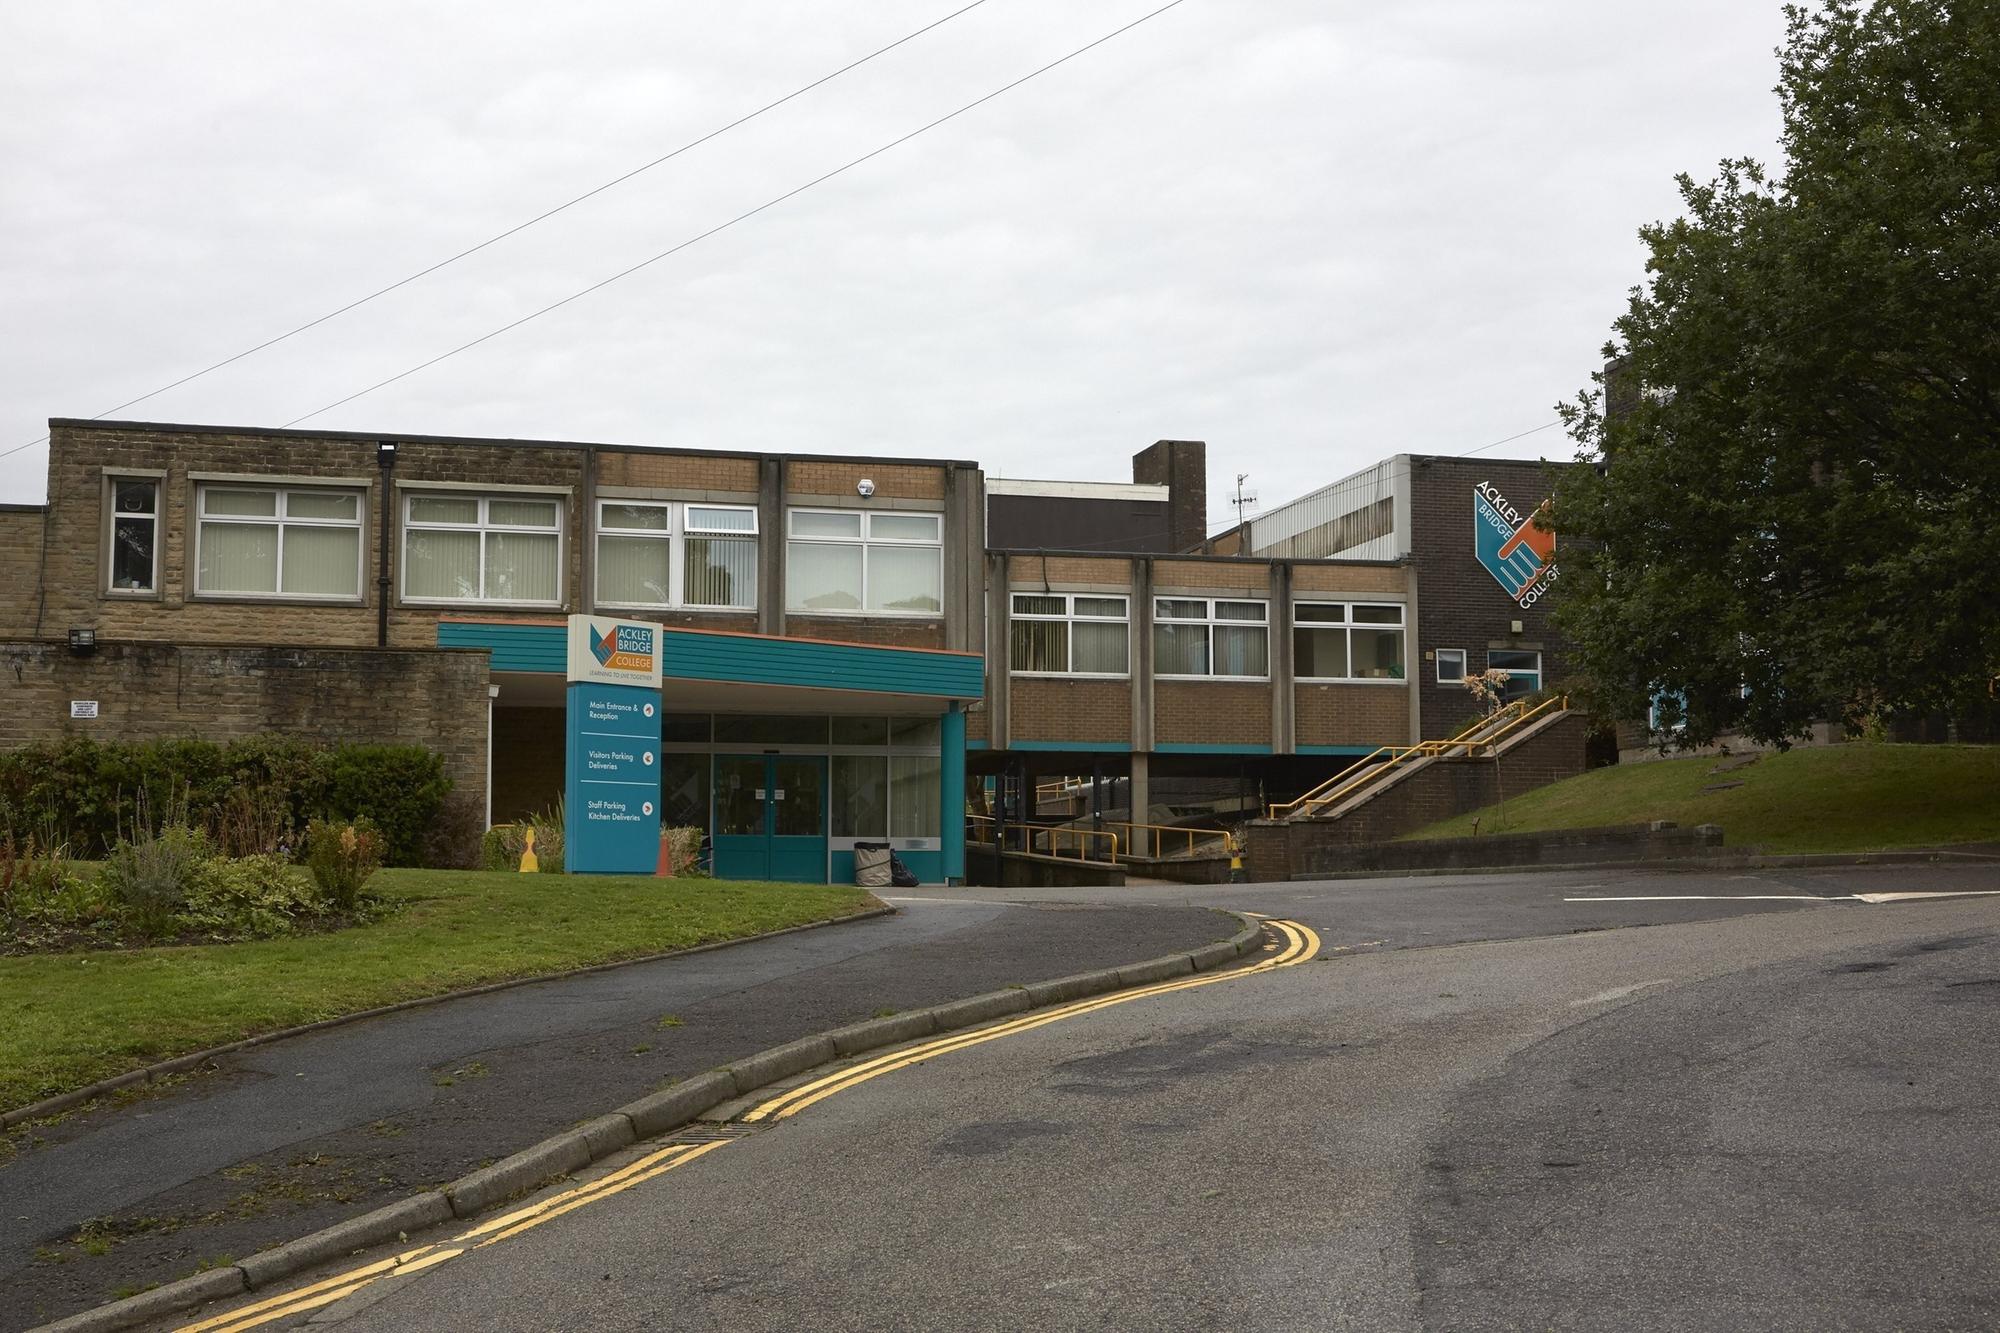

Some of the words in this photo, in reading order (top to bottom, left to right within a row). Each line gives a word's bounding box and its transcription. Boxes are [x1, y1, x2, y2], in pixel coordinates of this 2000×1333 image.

[1476, 480, 1523, 525] ACKLEY
[1478, 504, 1512, 541] BRIDGE
[618, 628, 652, 641] ACKLEY
[618, 641, 652, 653] BRIDGE
[616, 656, 651, 668] COLLEGE
[589, 670, 613, 678] LEARNING
[630, 673, 652, 681] TOGETHER
[589, 701, 605, 710] Main
[606, 702, 632, 712] Entrance
[633, 703, 639, 712] &
[589, 710, 619, 721] Reception
[589, 750, 610, 760] Visitors
[611, 752, 634, 762] Parking
[589, 761, 618, 770] Deliveries
[588, 800, 603, 809] Staff
[603, 801, 626, 812] Parking
[588, 811, 611, 821] Kitchen
[612, 812, 641, 822] Deliveries
